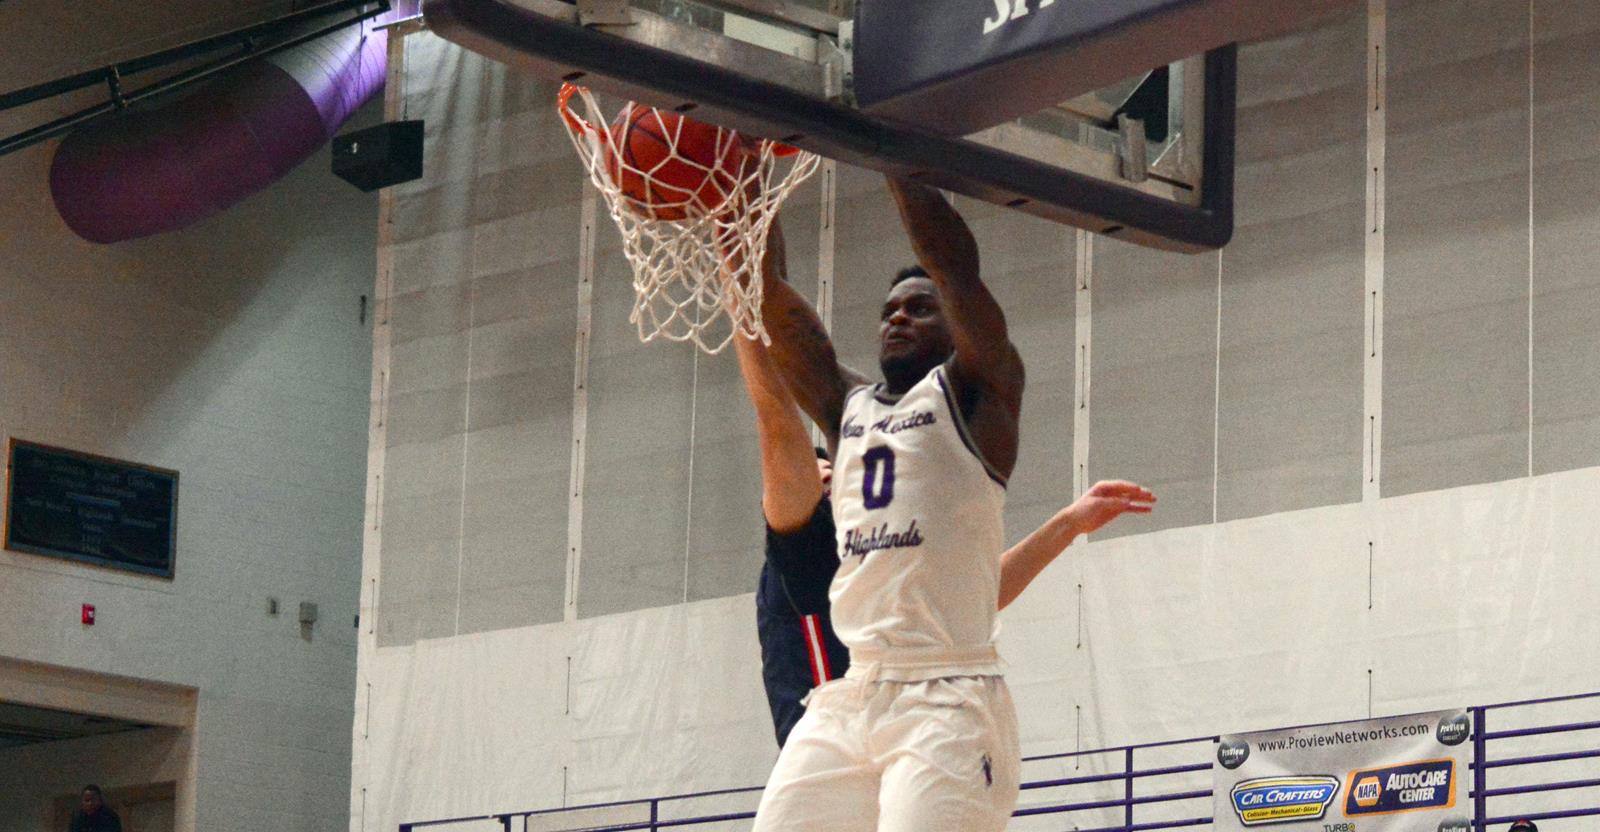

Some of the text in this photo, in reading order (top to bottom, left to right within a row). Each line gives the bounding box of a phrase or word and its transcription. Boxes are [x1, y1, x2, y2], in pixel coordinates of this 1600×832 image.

[871, 410, 937, 434] Mexico
[862, 445, 895, 511] 0
[843, 519, 924, 563] Highlands
[1258, 723, 1429, 752] www.ProviewNetworks.com
[1357, 783, 1378, 799] NAPA
[1399, 787, 1435, 803] CENTER
